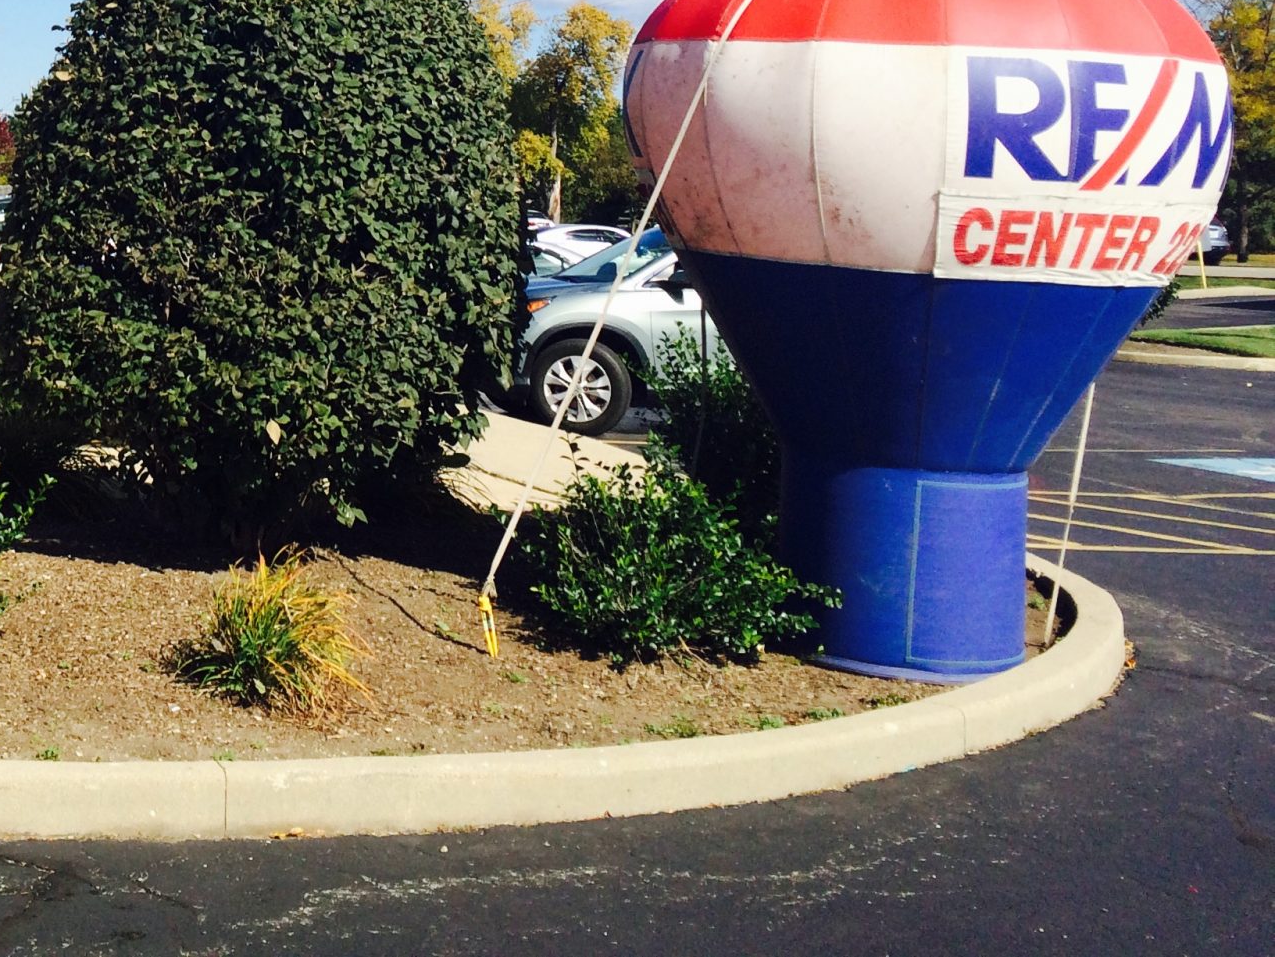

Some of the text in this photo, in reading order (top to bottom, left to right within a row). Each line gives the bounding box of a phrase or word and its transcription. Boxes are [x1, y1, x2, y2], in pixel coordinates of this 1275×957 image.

[963, 55, 1234, 192] RE/M
[952, 207, 1207, 275] CENTER 22
